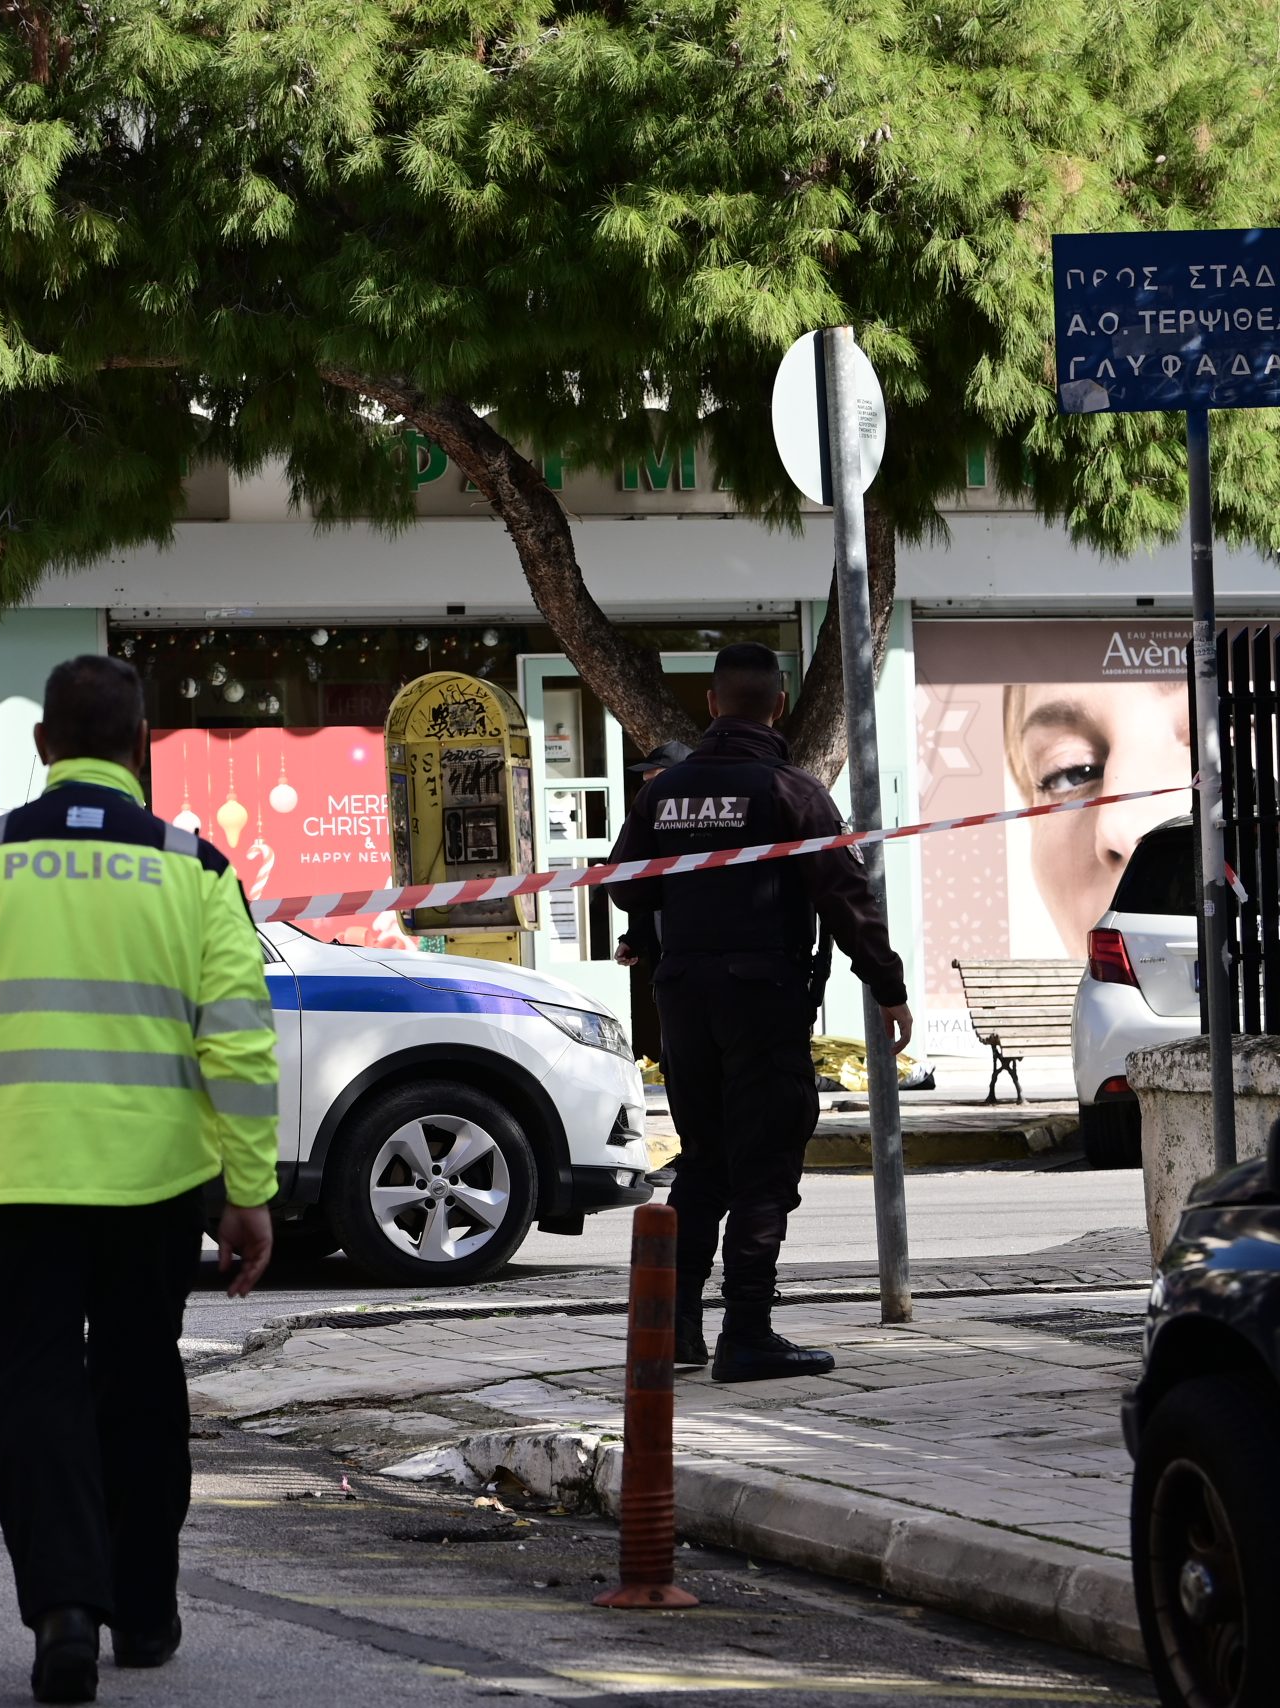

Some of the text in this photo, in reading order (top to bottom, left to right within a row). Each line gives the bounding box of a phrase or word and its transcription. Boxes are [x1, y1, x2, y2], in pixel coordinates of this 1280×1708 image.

[1066, 307, 1280, 337] Α.Ο. ΤΕΡΨΙΘΕ
[1127, 631, 1146, 640] EAU
[303, 816, 389, 836] CHRIST
[364, 836, 376, 849] &
[300, 852, 351, 863] HAPPY
[4, 850, 163, 886] POLICE
